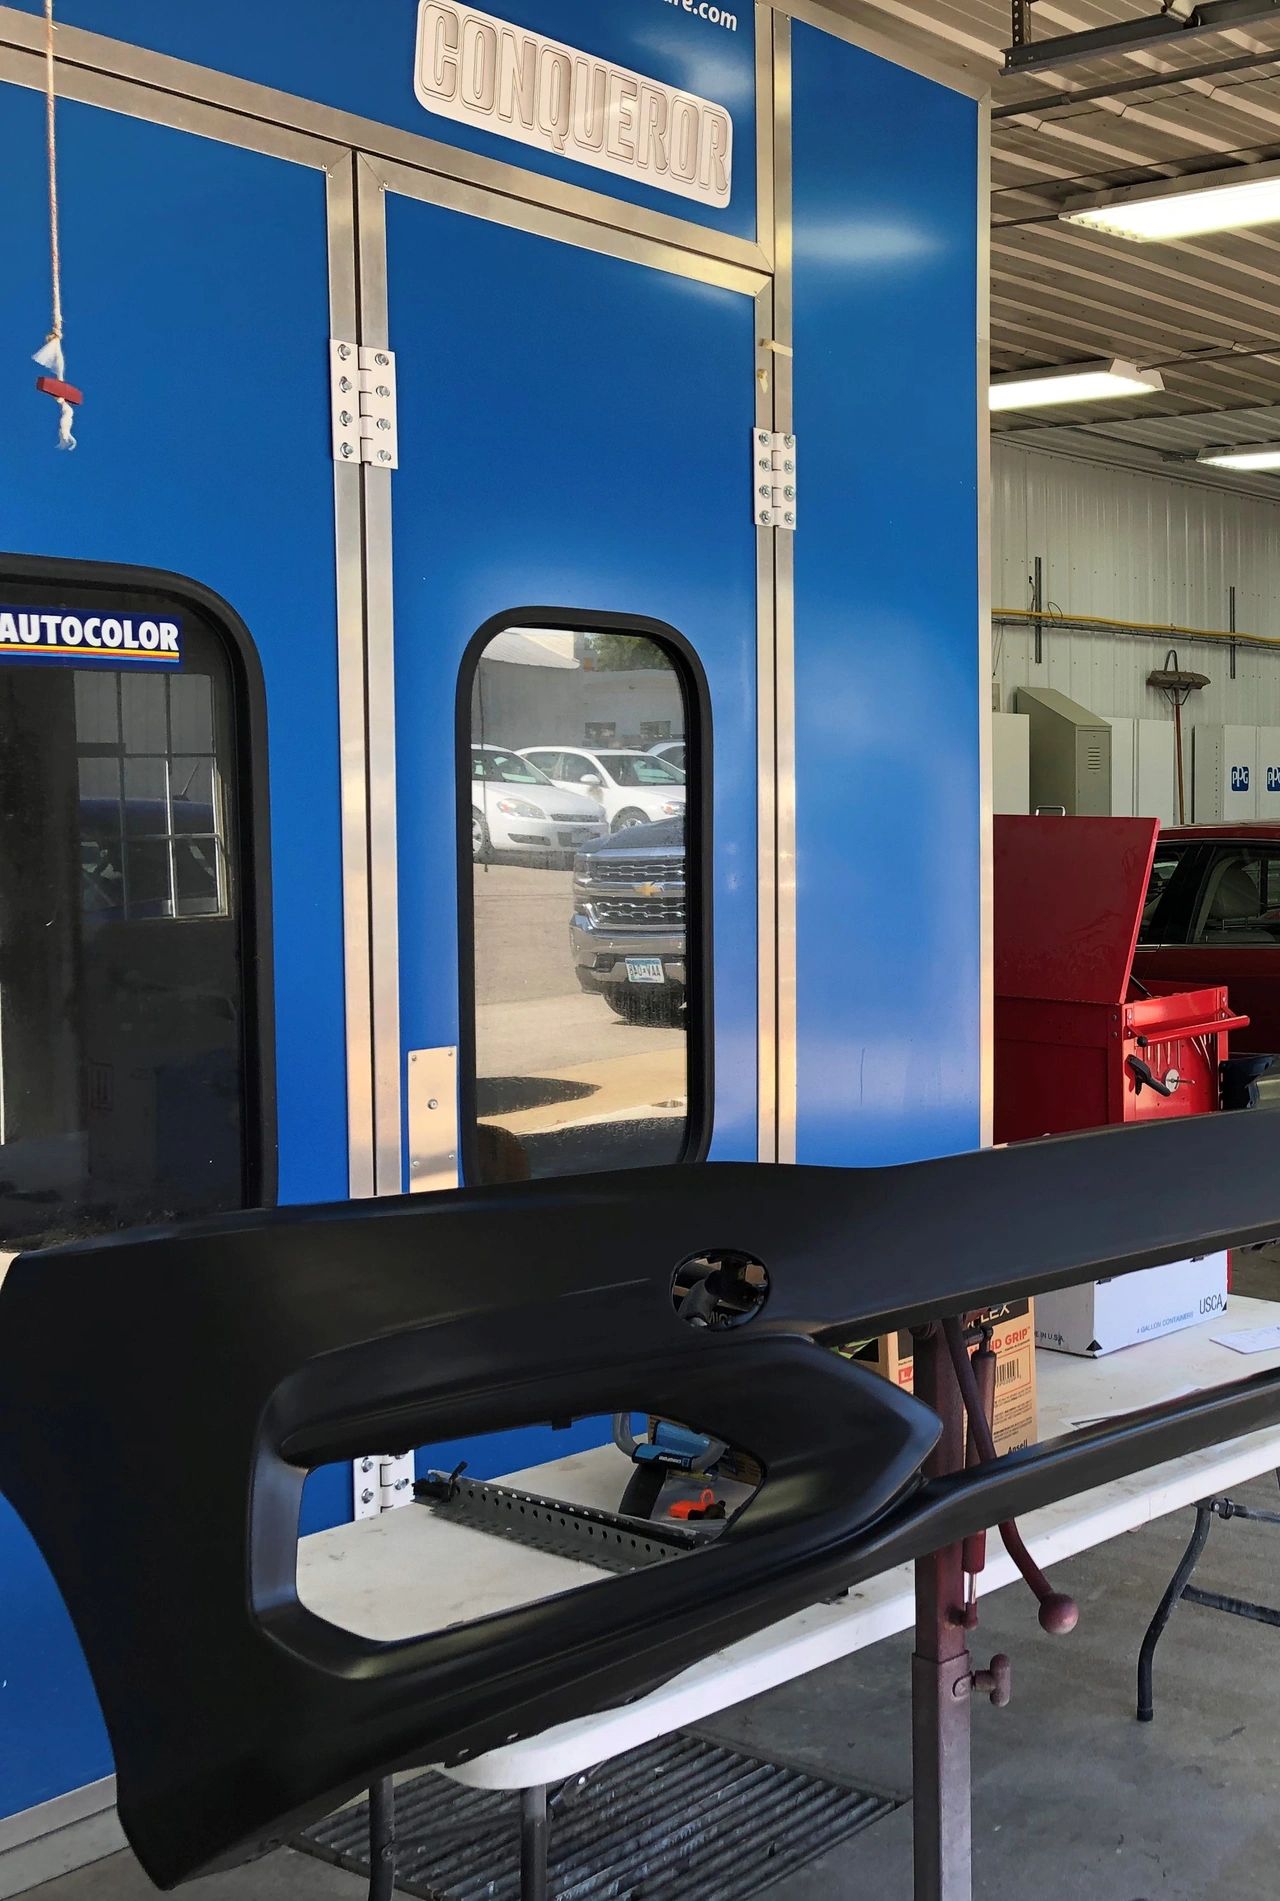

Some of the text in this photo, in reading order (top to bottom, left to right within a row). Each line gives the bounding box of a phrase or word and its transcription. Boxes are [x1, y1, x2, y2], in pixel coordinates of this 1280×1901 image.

[420, 1, 729, 195] CONQUEROR
[0, 612, 179, 651] AUTOCOLOR
[1232, 767, 1249, 787] PPG
[1200, 1293, 1223, 1315] USCA
